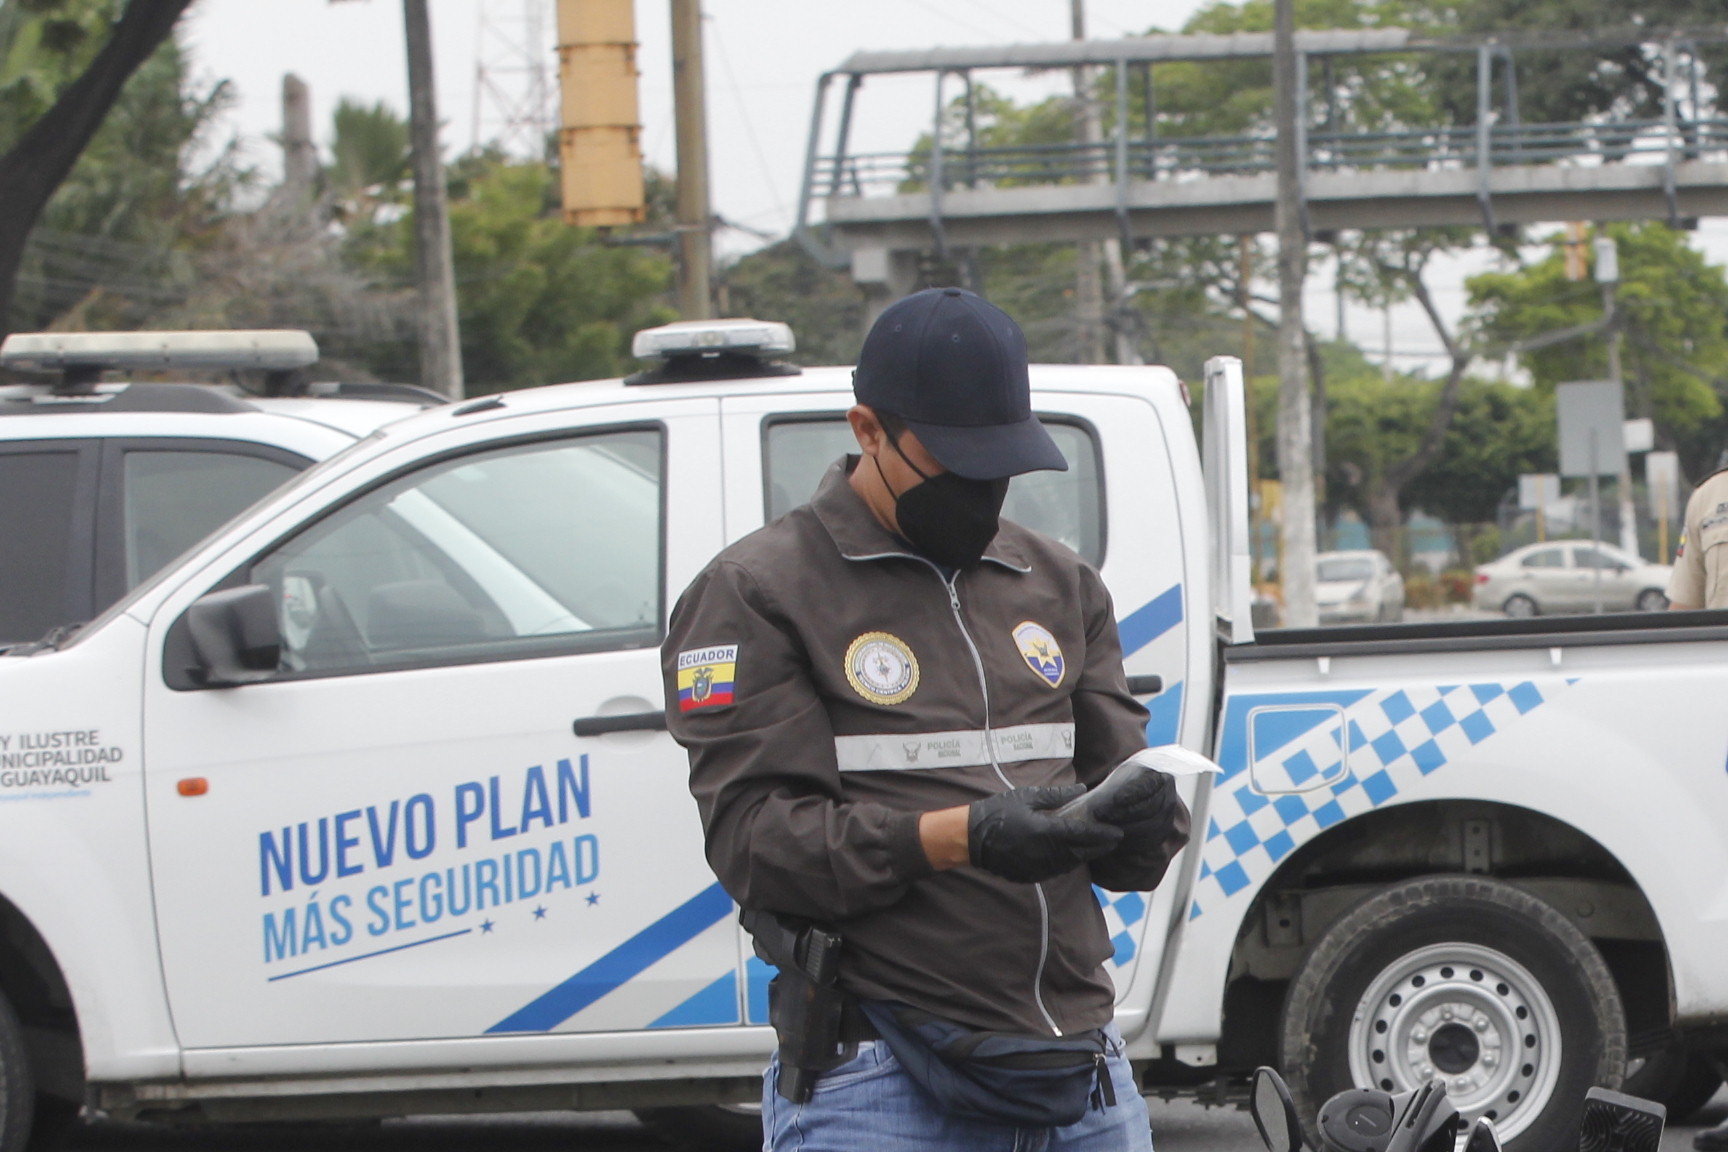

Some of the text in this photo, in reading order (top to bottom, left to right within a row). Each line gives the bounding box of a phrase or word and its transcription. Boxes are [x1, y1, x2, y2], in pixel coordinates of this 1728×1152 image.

[680, 649, 734, 667] ECUADOR
[19, 729, 100, 749] ILUSTRE
[0, 747, 123, 769] NICIPALIDAD
[0, 766, 112, 788] GUAYAQUIL
[259, 753, 591, 897] NUEVO PLAN
[263, 833, 599, 963] MÁS SEGURIDAD
